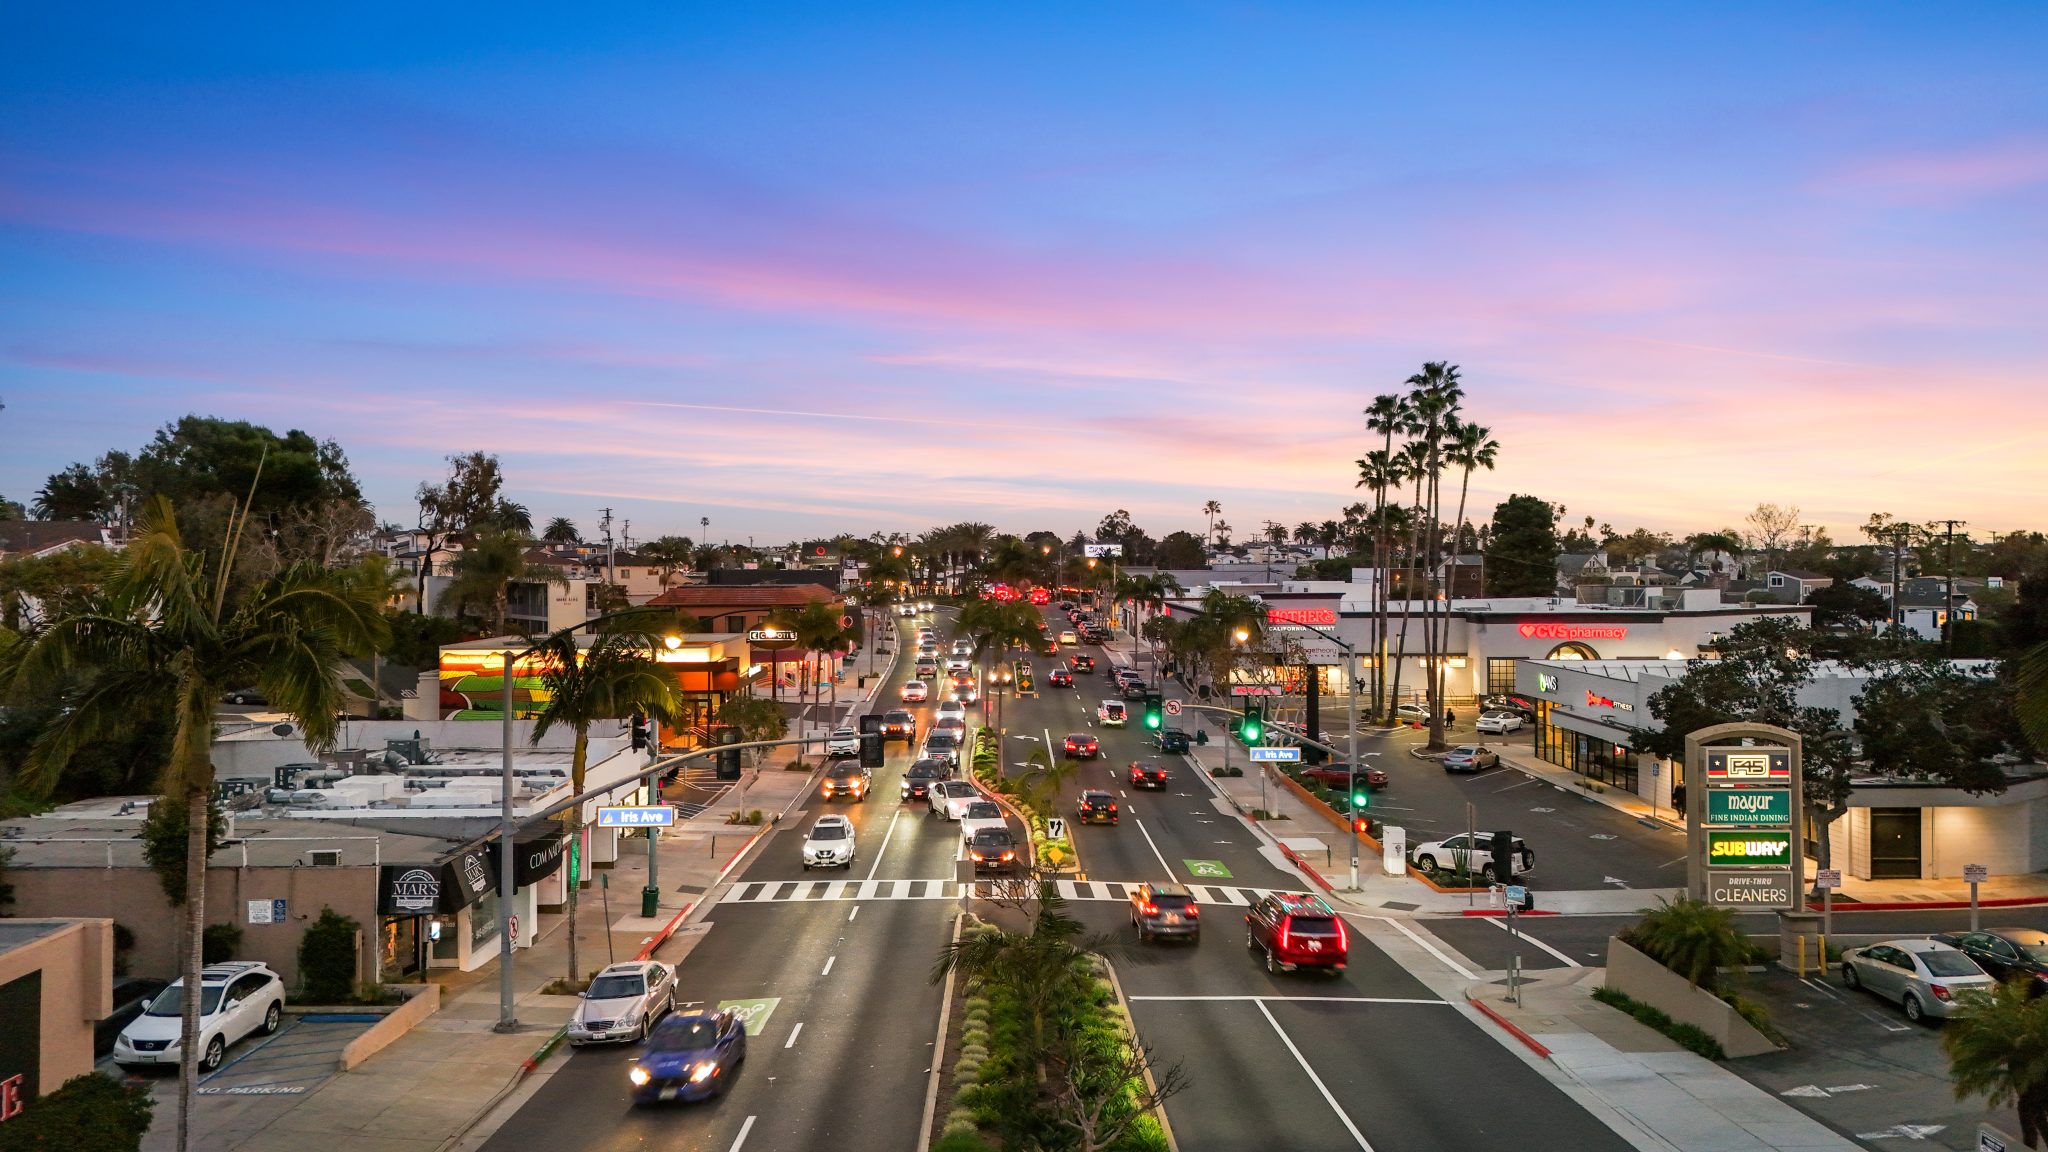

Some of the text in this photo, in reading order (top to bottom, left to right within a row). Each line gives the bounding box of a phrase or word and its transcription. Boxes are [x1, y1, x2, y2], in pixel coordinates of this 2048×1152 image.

[1536, 625, 1627, 640] CVS pharmacy
[1613, 701, 1633, 711] FITNESS
[1265, 751, 1293, 759] Iris Ave
[1731, 759, 1765, 774] F45
[1728, 795, 1774, 813] mayur
[621, 811, 663, 823] Iris Ave
[1710, 814, 1789, 822] FINE INDIAN DINING
[1711, 841, 1788, 856] SUBWAY
[393, 883, 439, 895] MAR'S
[1714, 888, 1787, 902] CLEANERS
[226, 1086, 305, 1094] PARKING
